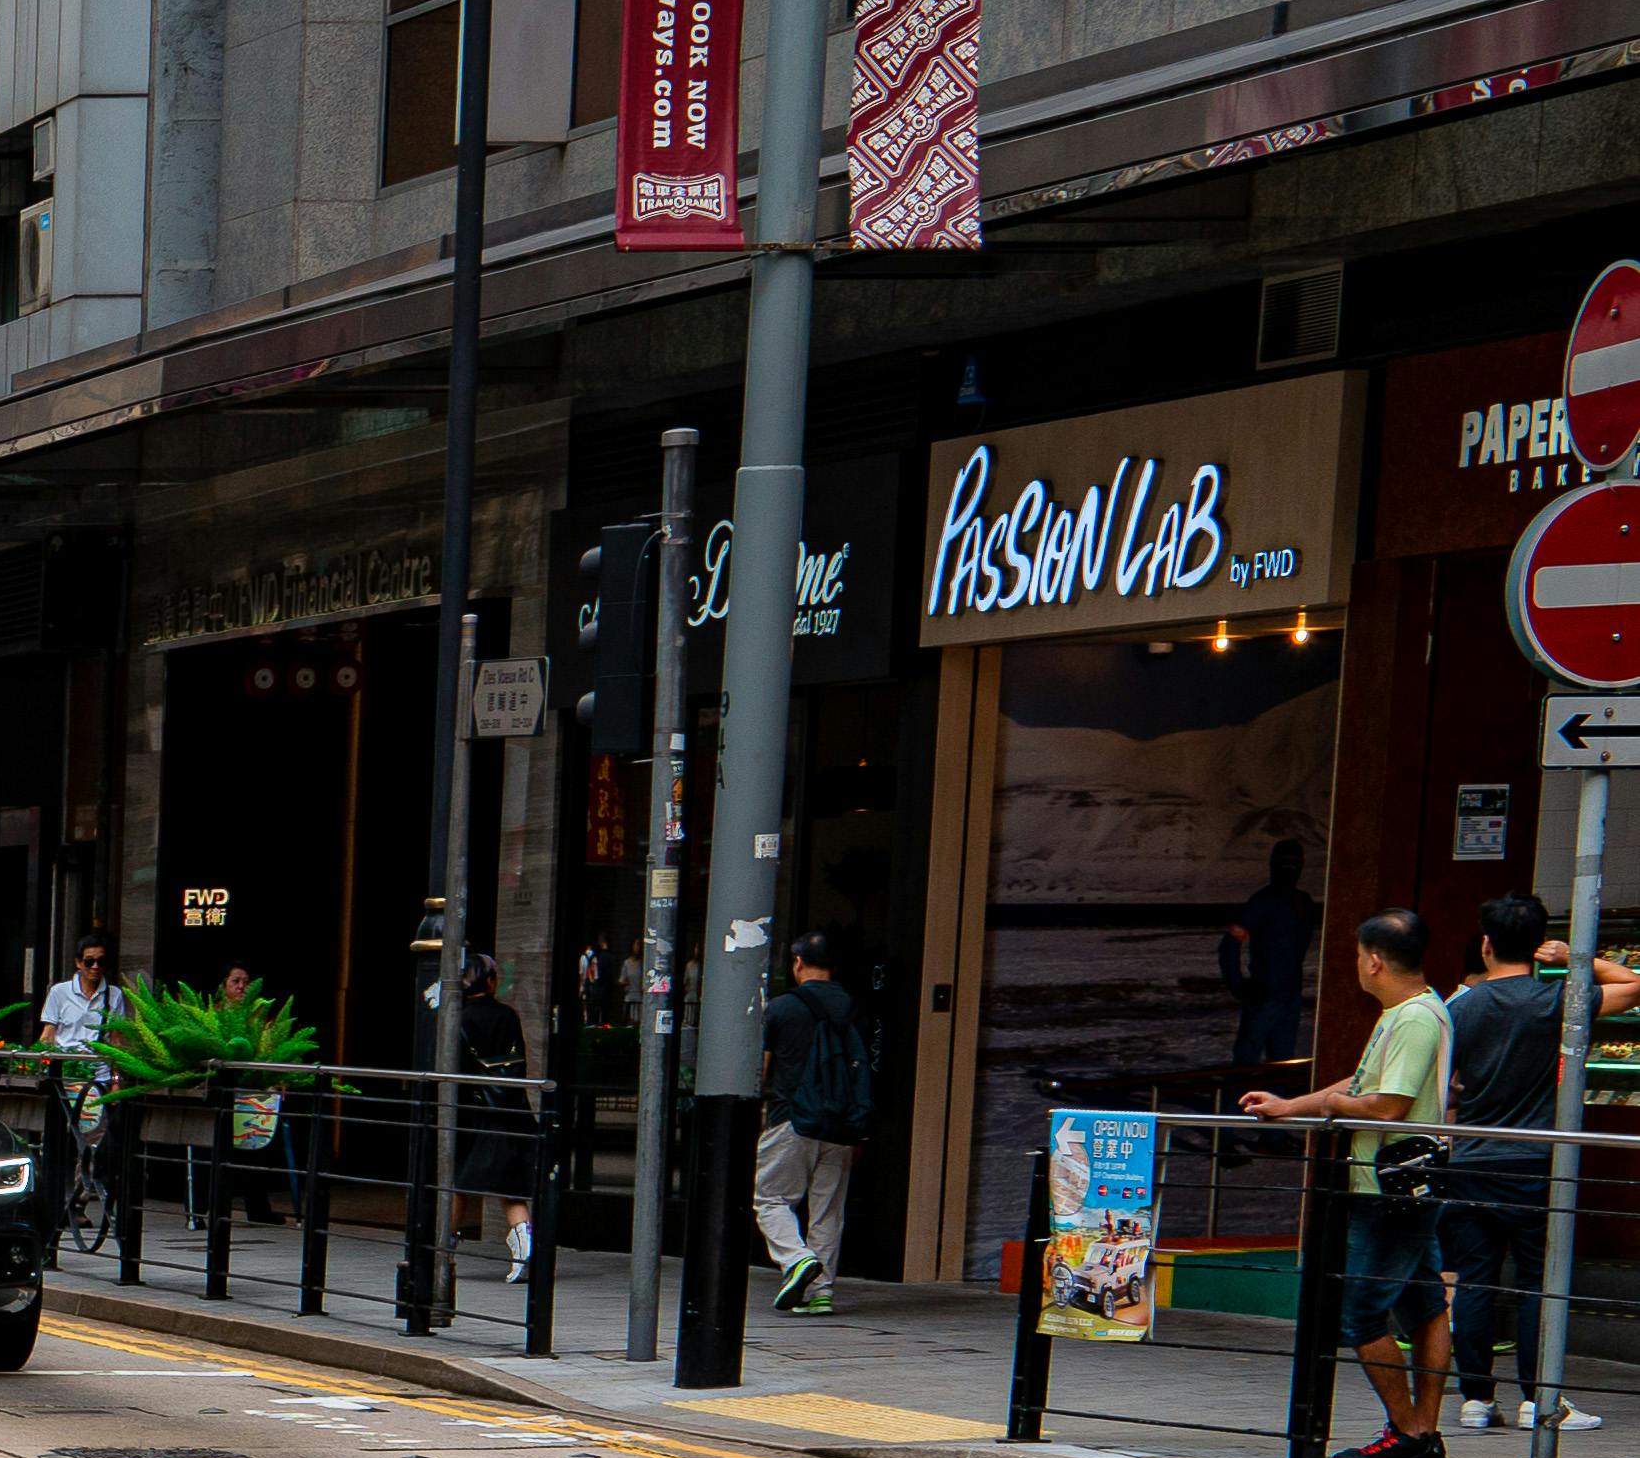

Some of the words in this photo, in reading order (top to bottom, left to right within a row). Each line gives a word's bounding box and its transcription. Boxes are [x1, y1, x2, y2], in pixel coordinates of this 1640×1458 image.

[686, 79, 708, 150] NOW
[882, 82, 964, 166] TRAMORAMIC
[639, 195, 721, 213] TRAMORAMIC
[1458, 398, 1570, 468] PAPER
[1230, 554, 1250, 588] by
[1253, 548, 1295, 579] FWD
[283, 551, 363, 621] Financial
[366, 548, 432, 604] Centre
[184, 888, 230, 906] FWD
[183, 908, 227, 926] 富衛
[1093, 1119, 1121, 1138] OPEN
[1122, 1121, 1149, 1139] NOW
[1092, 1139, 1134, 1160] 營業中
